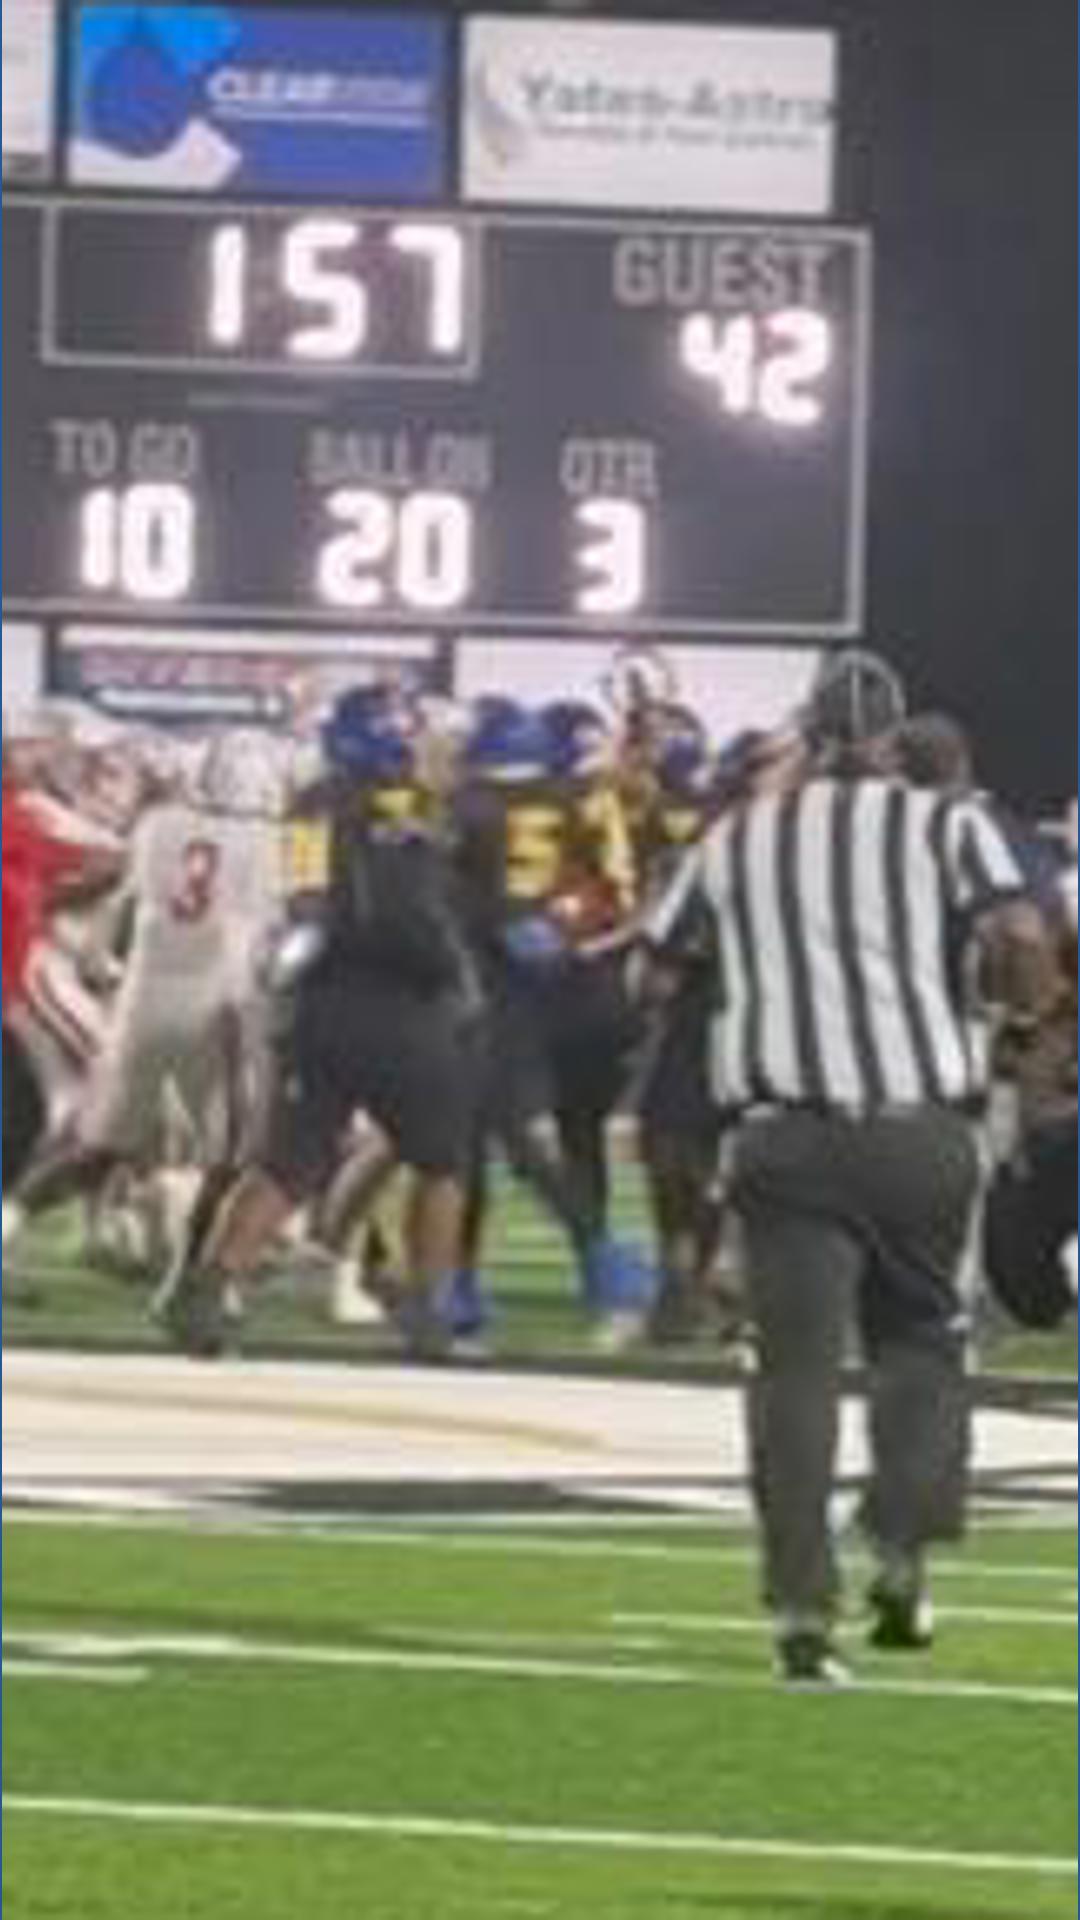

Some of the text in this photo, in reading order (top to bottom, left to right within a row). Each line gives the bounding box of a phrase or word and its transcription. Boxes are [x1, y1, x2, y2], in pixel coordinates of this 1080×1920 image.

[613, 238, 832, 308] GUEST
[680, 309, 830, 424] 42
[50, 420, 198, 482] TO GO
[559, 439, 657, 496] QTR
[80, 483, 195, 600] 10
[316, 490, 471, 608] 20
[573, 498, 645, 613] 3
